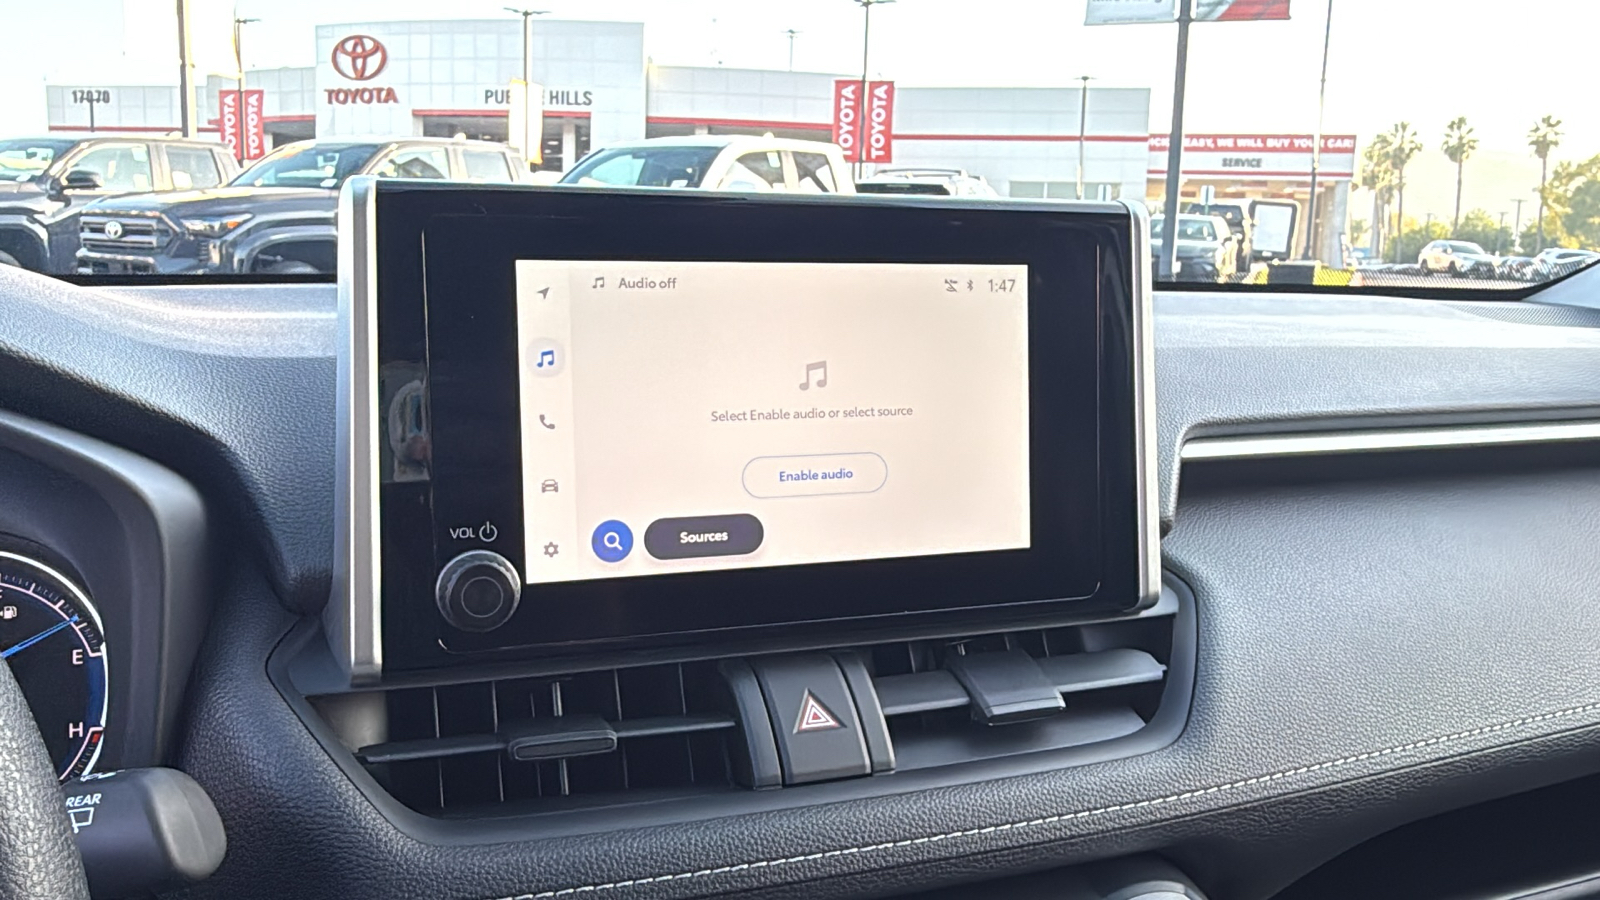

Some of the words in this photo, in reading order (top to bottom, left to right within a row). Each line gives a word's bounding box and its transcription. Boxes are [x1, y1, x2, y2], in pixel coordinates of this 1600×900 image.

[72, 90, 110, 103] 17070
[325, 87, 398, 105] TOYOTA
[549, 90, 593, 106] HILLS
[247, 93, 261, 157] TOYOTA
[870, 84, 888, 160] TOYOTA
[1217, 137, 1235, 148] WE
[1237, 138, 1264, 148] WILL
[1267, 138, 1291, 148] BUY
[1222, 157, 1263, 169] SERVICE
[618, 277, 655, 290] Audio
[658, 276, 677, 290] off
[988, 279, 1016, 293] 1:47
[711, 410, 747, 422] Select
[750, 408, 791, 421] Enable
[793, 408, 826, 420] audio
[828, 408, 840, 418] or
[843, 407, 875, 418] select
[877, 406, 913, 417] source
[779, 470, 819, 482] Enable
[821, 468, 854, 480] audio
[449, 526, 475, 541] VOL
[680, 530, 729, 545] Sources
[72, 649, 84, 665] E
[68, 722, 84, 738] H
[65, 793, 102, 807] REAR
